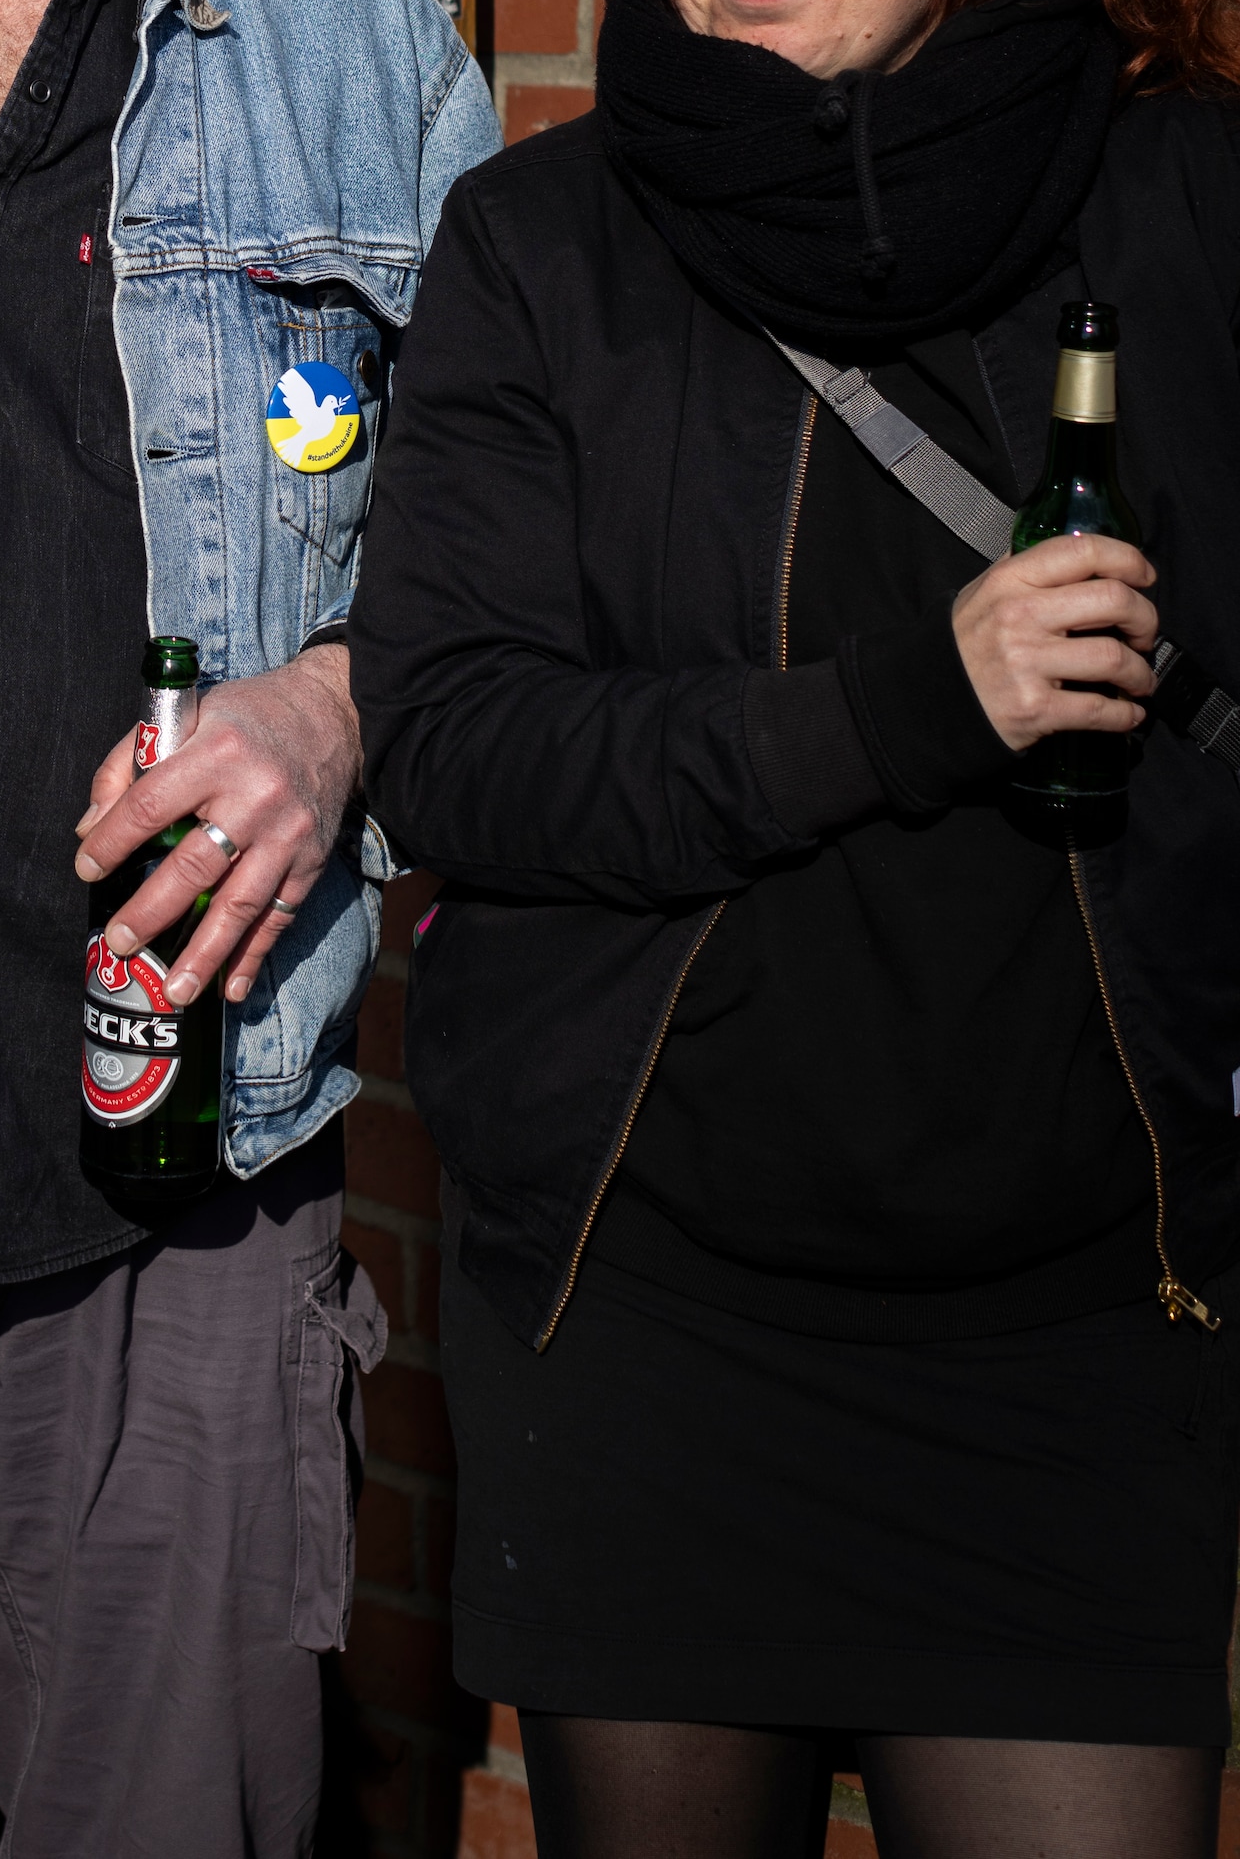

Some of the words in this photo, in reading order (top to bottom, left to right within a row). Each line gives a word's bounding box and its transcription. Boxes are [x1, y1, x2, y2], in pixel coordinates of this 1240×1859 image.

[307, 422, 353, 462] #standwithukraine
[110, 997, 141, 1007] TRADEMARK
[83, 1005, 179, 1049] ECK'S
[88, 1086, 124, 1106] GERMANY
[145, 1065, 161, 1086] 1873
